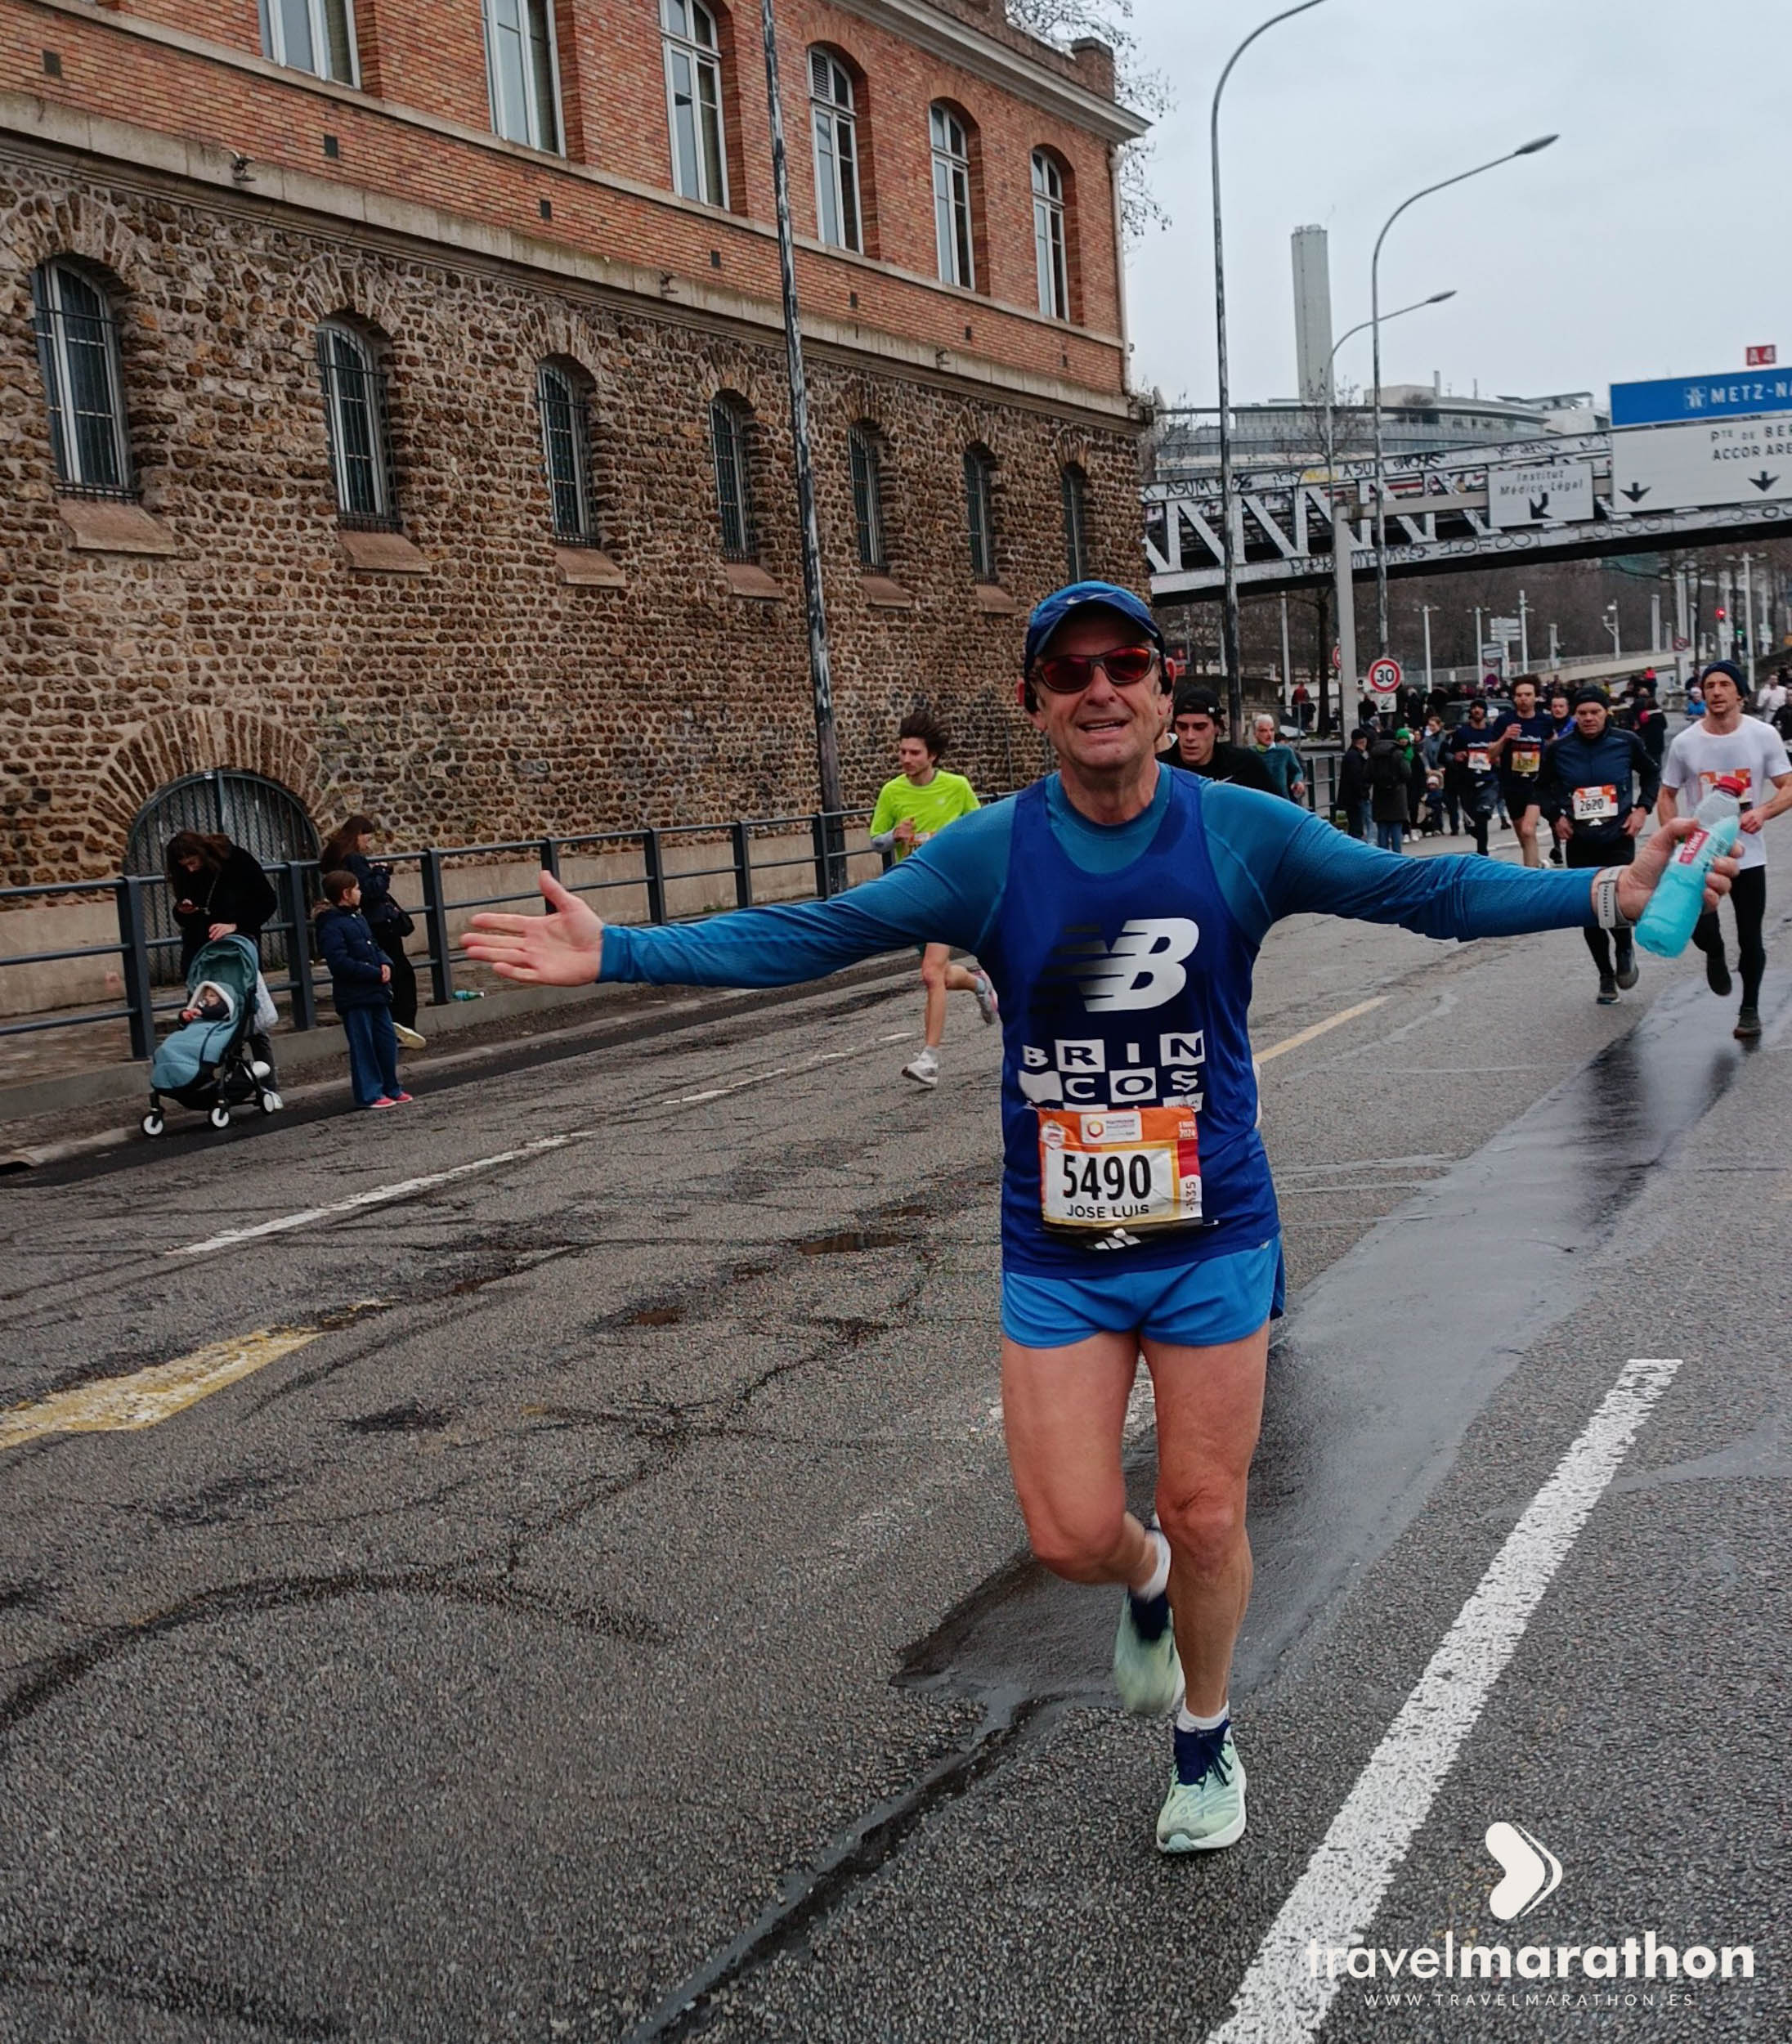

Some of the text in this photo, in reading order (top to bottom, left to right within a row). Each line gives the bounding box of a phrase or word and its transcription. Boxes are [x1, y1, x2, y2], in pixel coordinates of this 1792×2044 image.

[1710, 381, 1792, 404] METZ-N
[1713, 446, 1761, 461] ACCOR
[1517, 469, 1564, 482] Institut
[1377, 669, 1395, 683] 30
[1580, 798, 1603, 812] 2620
[1065, 1070, 1198, 1100] COS
[1063, 1154, 1152, 1201] 5490
[1066, 1204, 1149, 1218] JOSE LUIS
